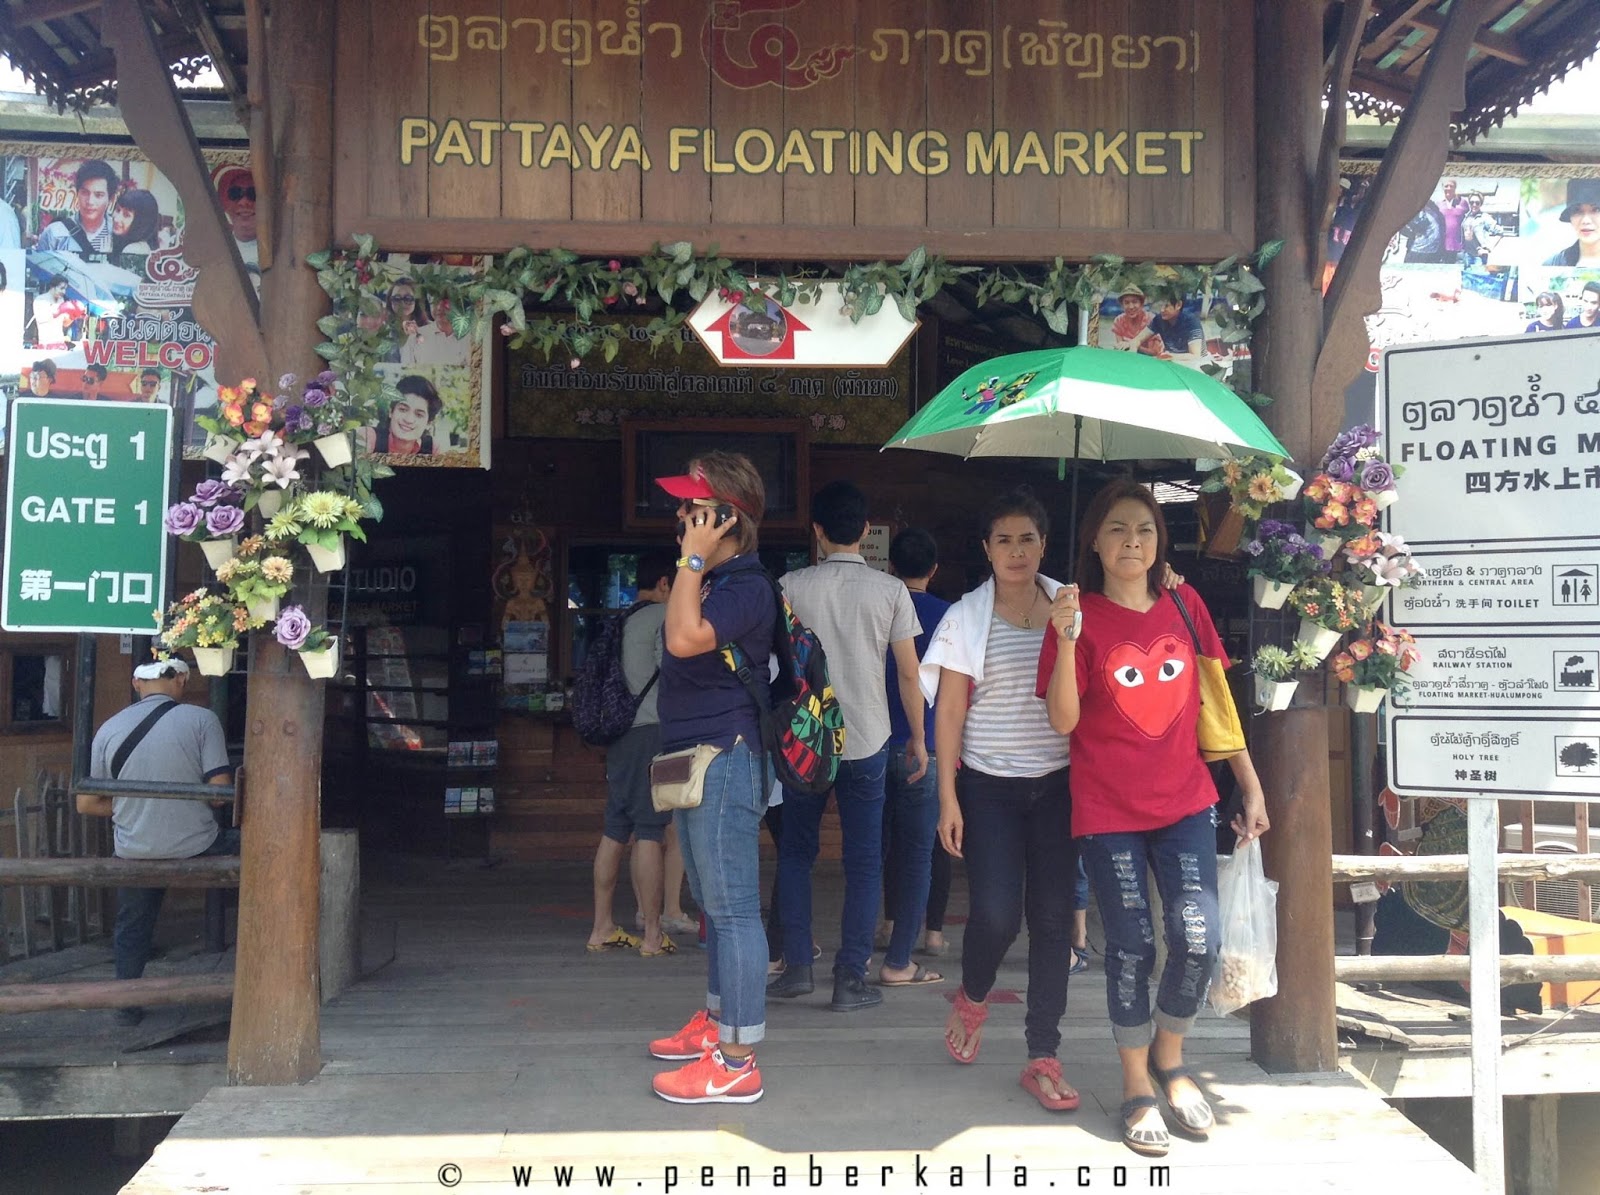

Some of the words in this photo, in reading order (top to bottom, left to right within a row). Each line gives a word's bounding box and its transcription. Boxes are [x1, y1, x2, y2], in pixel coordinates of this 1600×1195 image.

[400, 117, 652, 172] PATTAYA
[668, 127, 950, 176] FLOATING
[965, 130, 1205, 176] MARKET
[82, 339, 220, 369] WELCO
[1402, 373, 1566, 431] ตลาดน้ำ
[26, 426, 108, 470] ประตู
[130, 431, 145, 461] 1
[1401, 435, 1557, 463] FLOATING
[21, 496, 116, 524] GATE
[134, 500, 148, 525] 1
[1466, 565, 1476, 577] &
[1511, 578, 1535, 586] AREA
[20, 569, 153, 604] 第一门口
[1456, 598, 1493, 609] 洗手间
[1497, 598, 1541, 609] TOILET
[1433, 661, 1472, 669] RAILWAY
[1476, 661, 1513, 669] STATION
[1419, 691, 1455, 699] FLOATING
[1452, 753, 1475, 761] HOLY
[1479, 754, 1500, 762] TREE
